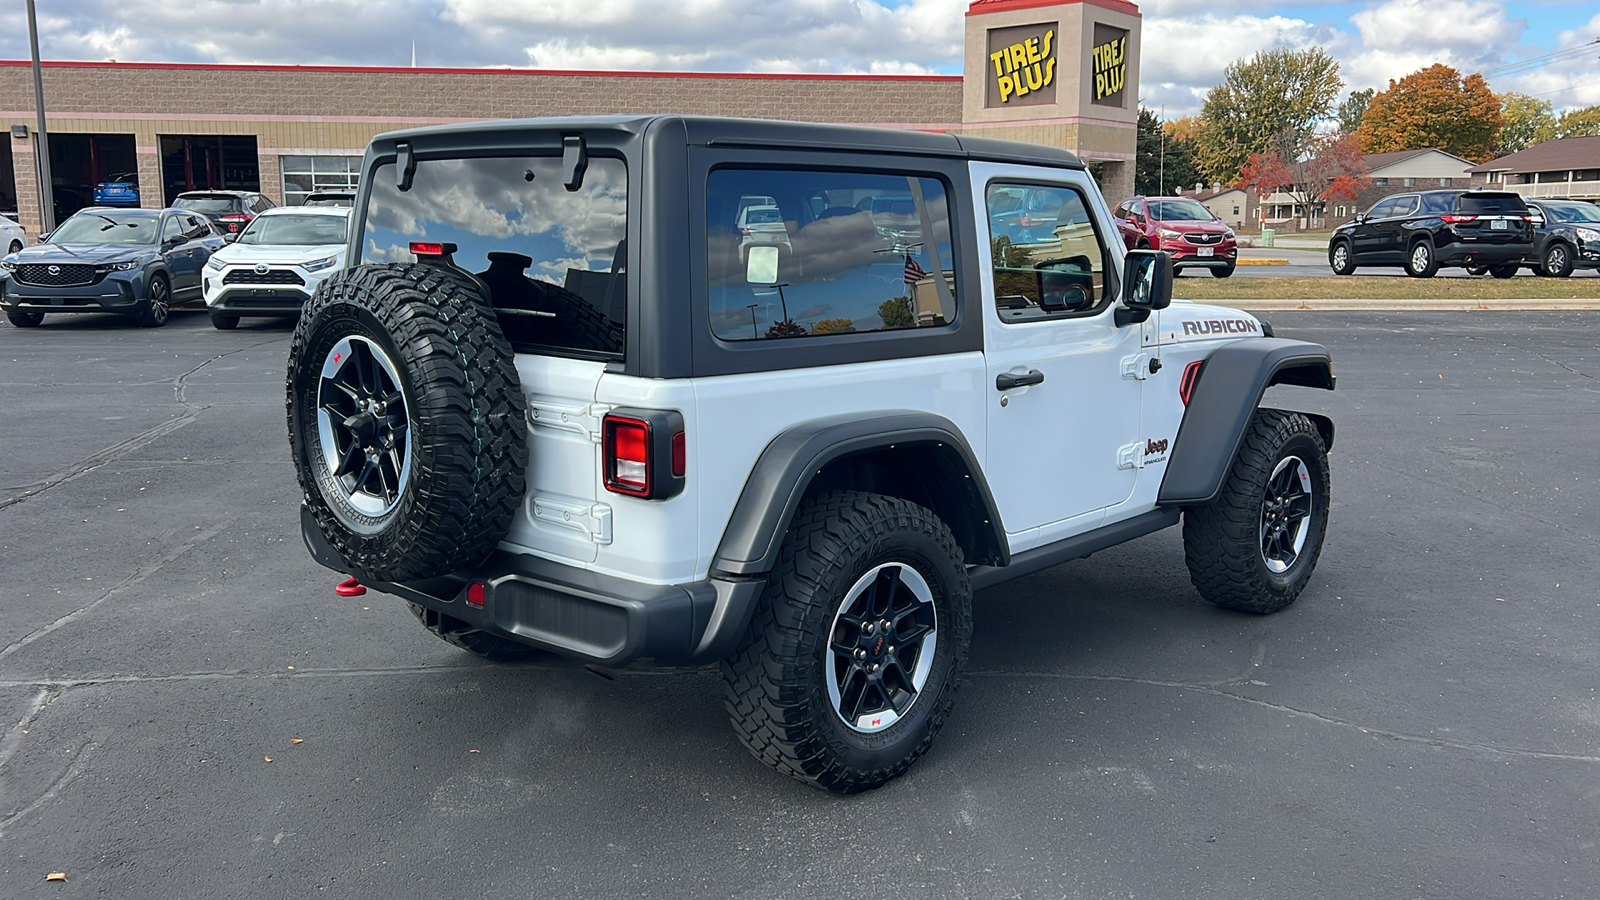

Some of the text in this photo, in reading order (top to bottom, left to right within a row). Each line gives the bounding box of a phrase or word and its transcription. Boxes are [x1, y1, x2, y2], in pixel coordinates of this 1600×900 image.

[990, 29, 1054, 77] TIRES
[1093, 36, 1126, 73] TIRES
[998, 57, 1056, 103] PLUS
[1096, 63, 1126, 100] PLUS
[1181, 319, 1258, 336] RUBICON
[1144, 438, 1168, 456] Jeep
[874, 636, 884, 655] Jeep
